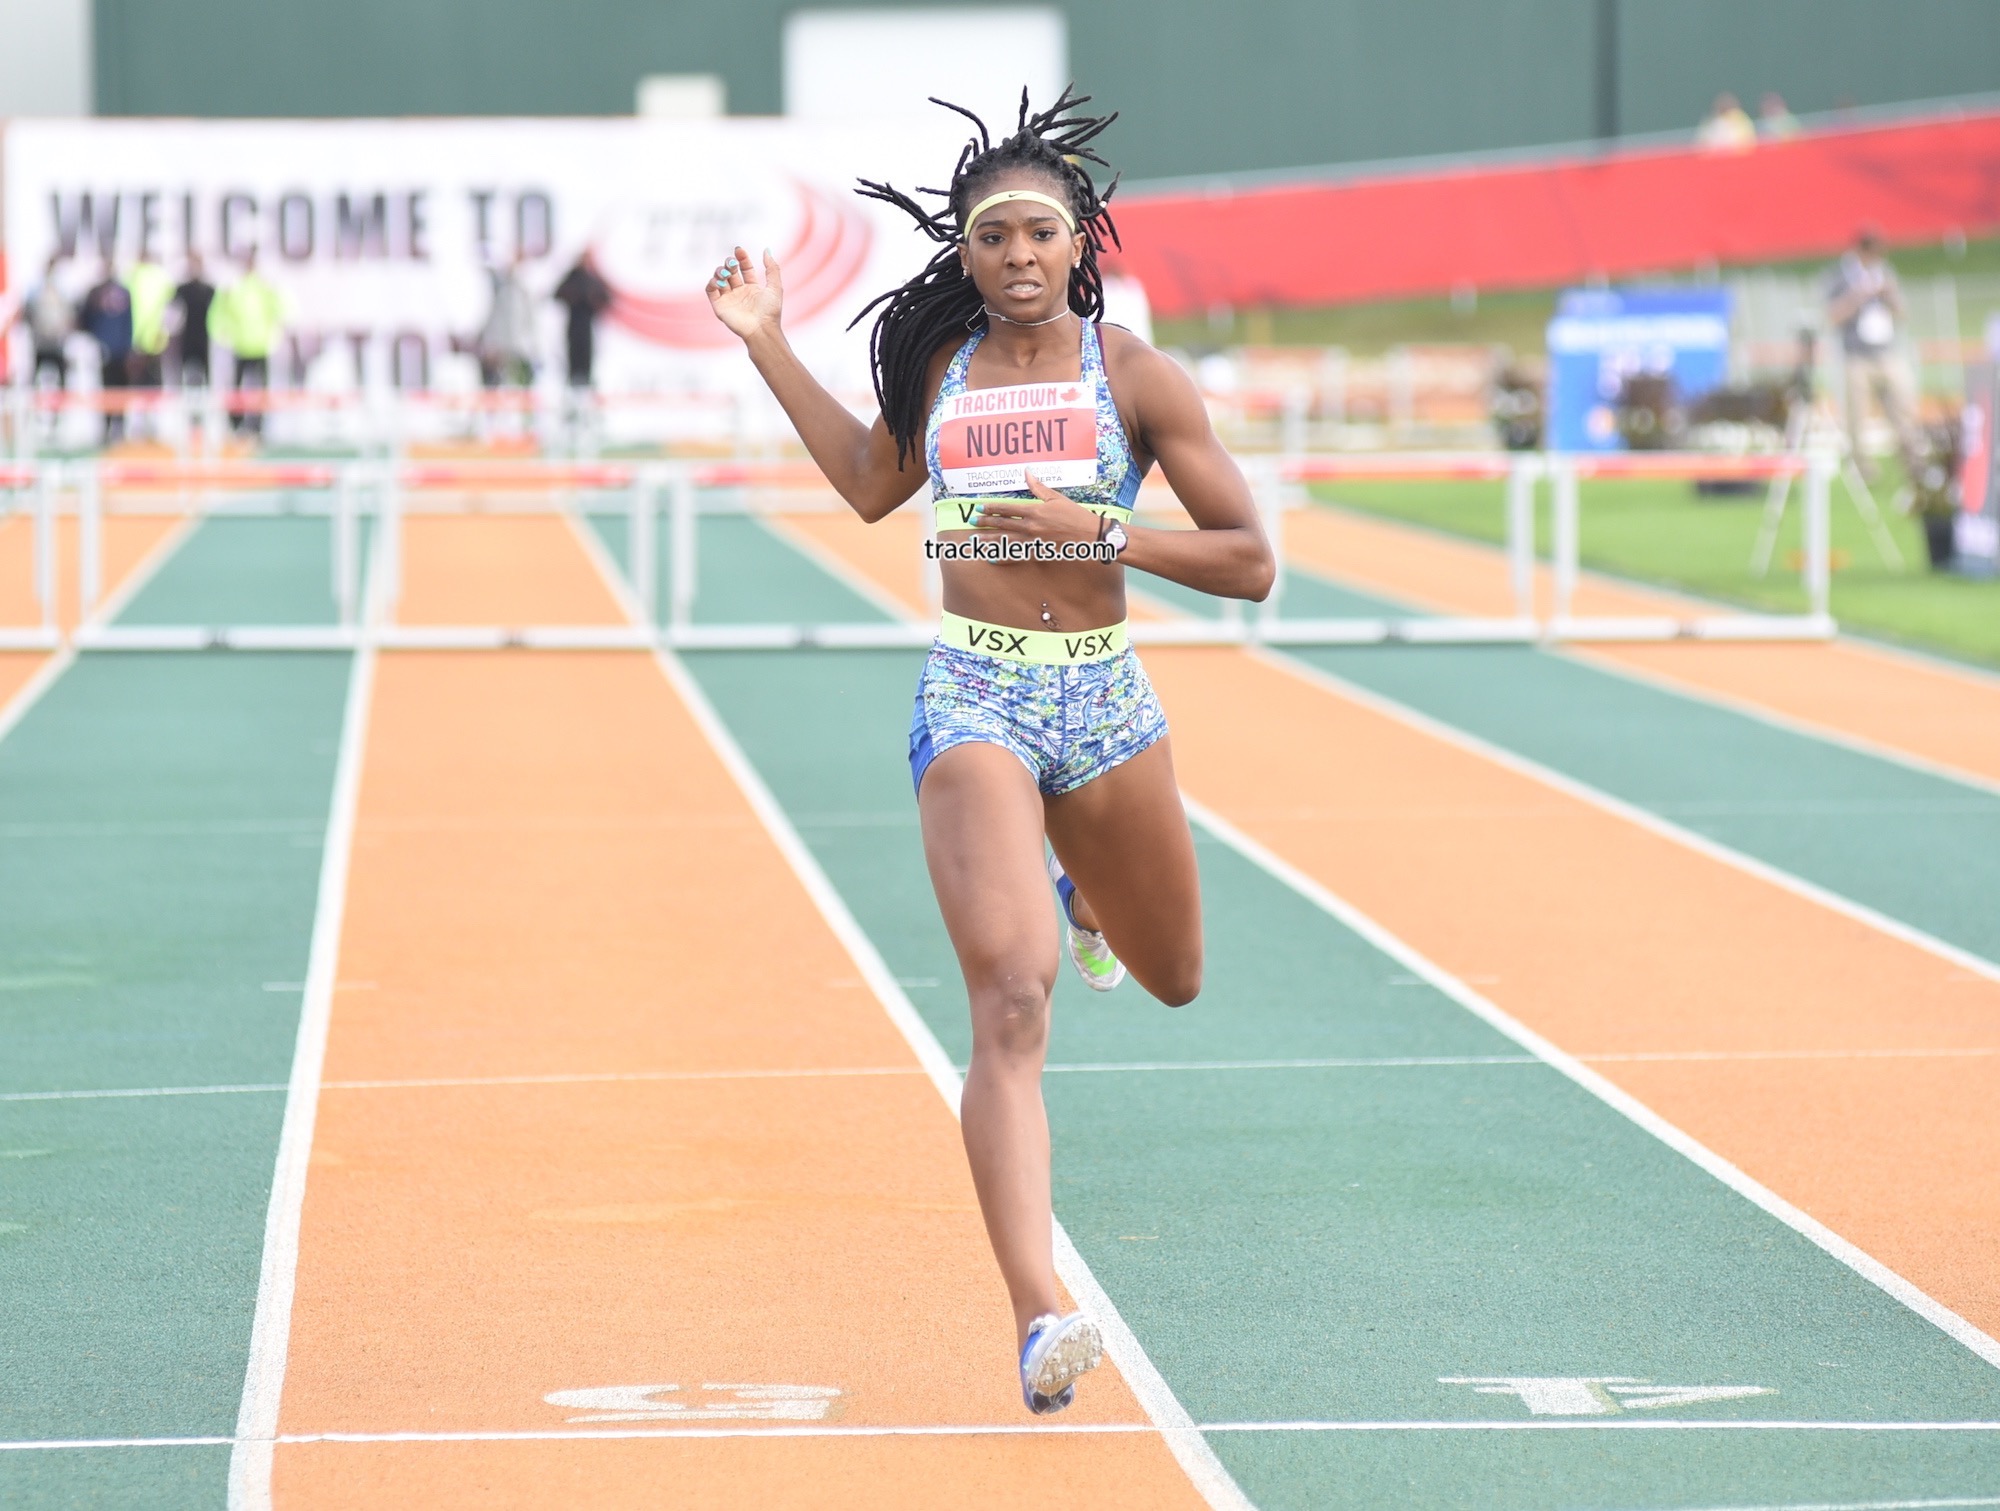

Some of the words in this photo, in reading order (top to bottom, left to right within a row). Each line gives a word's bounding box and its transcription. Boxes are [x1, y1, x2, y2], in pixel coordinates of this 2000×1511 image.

[50, 189, 428, 259] WELCOME
[471, 189, 552, 259] TO
[954, 387, 1057, 415] TRACKTOWN
[966, 418, 1068, 458] NUGENT
[966, 468, 1022, 481] TRACKTOWN
[967, 479, 1016, 488] EDMONTON
[968, 625, 1029, 656] VSX
[1065, 632, 1113, 659] VSX
